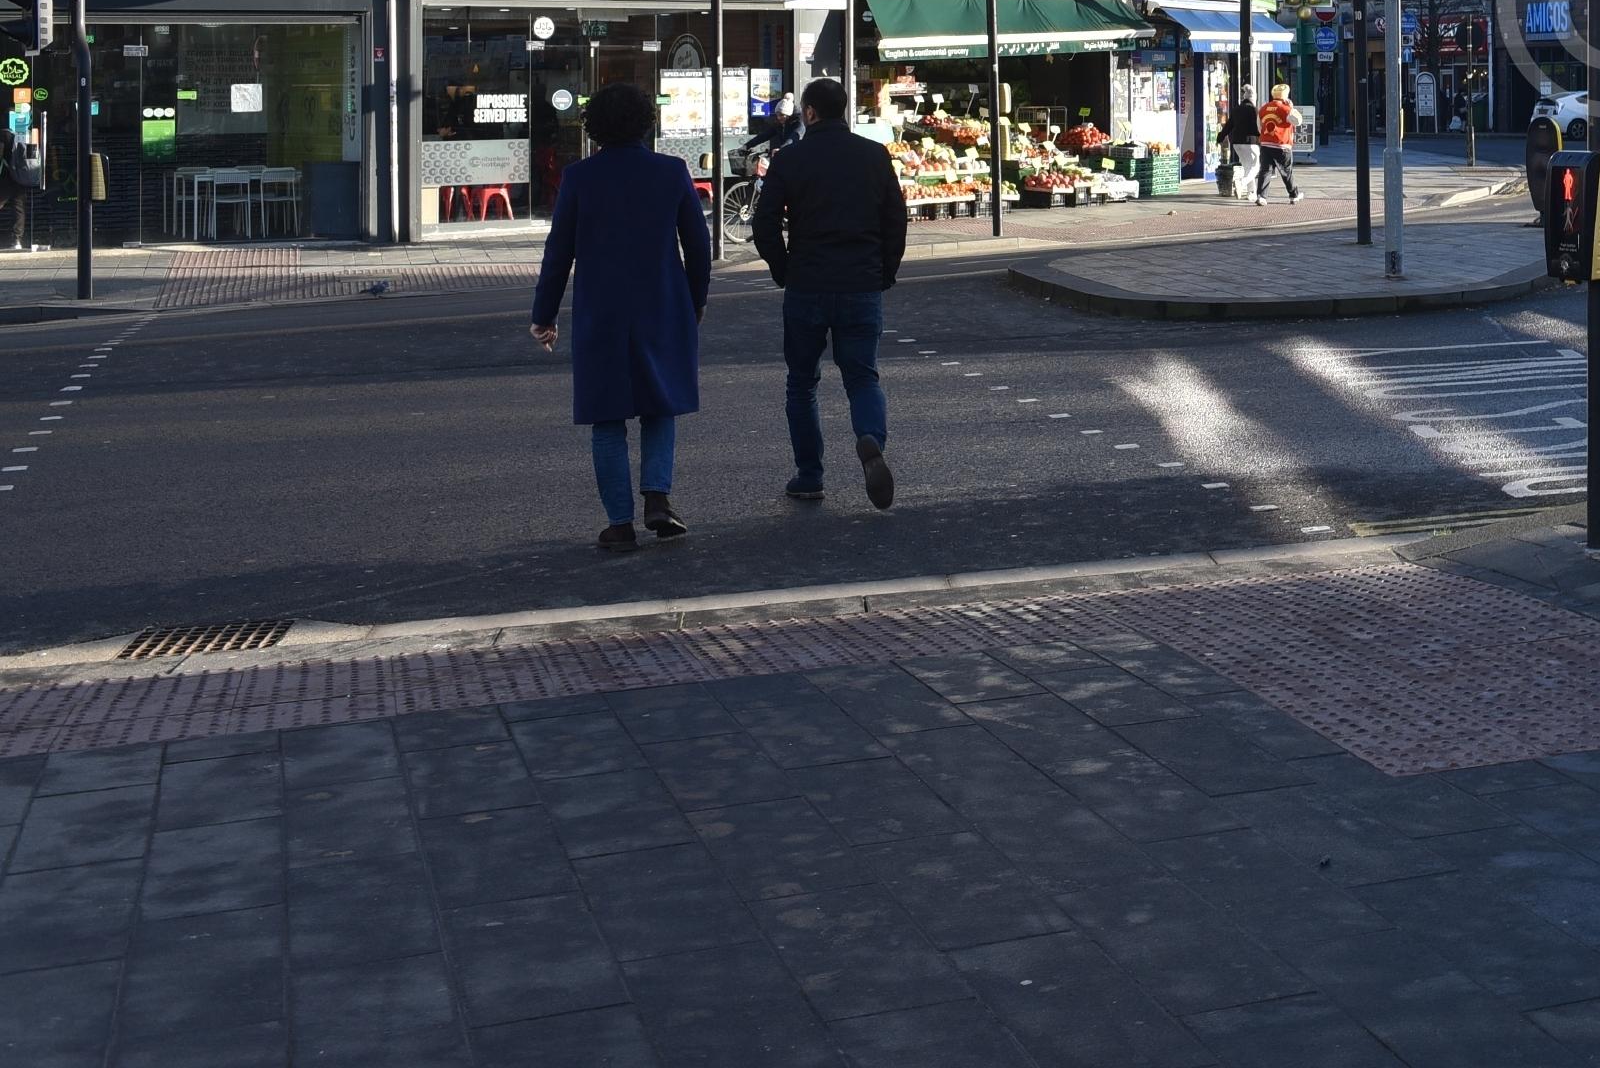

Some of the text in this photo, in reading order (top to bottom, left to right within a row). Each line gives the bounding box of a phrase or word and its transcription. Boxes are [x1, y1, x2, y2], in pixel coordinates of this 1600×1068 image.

[1525, 2, 1569, 32] AMIGOS
[474, 108, 527, 123] SERVED HERE
